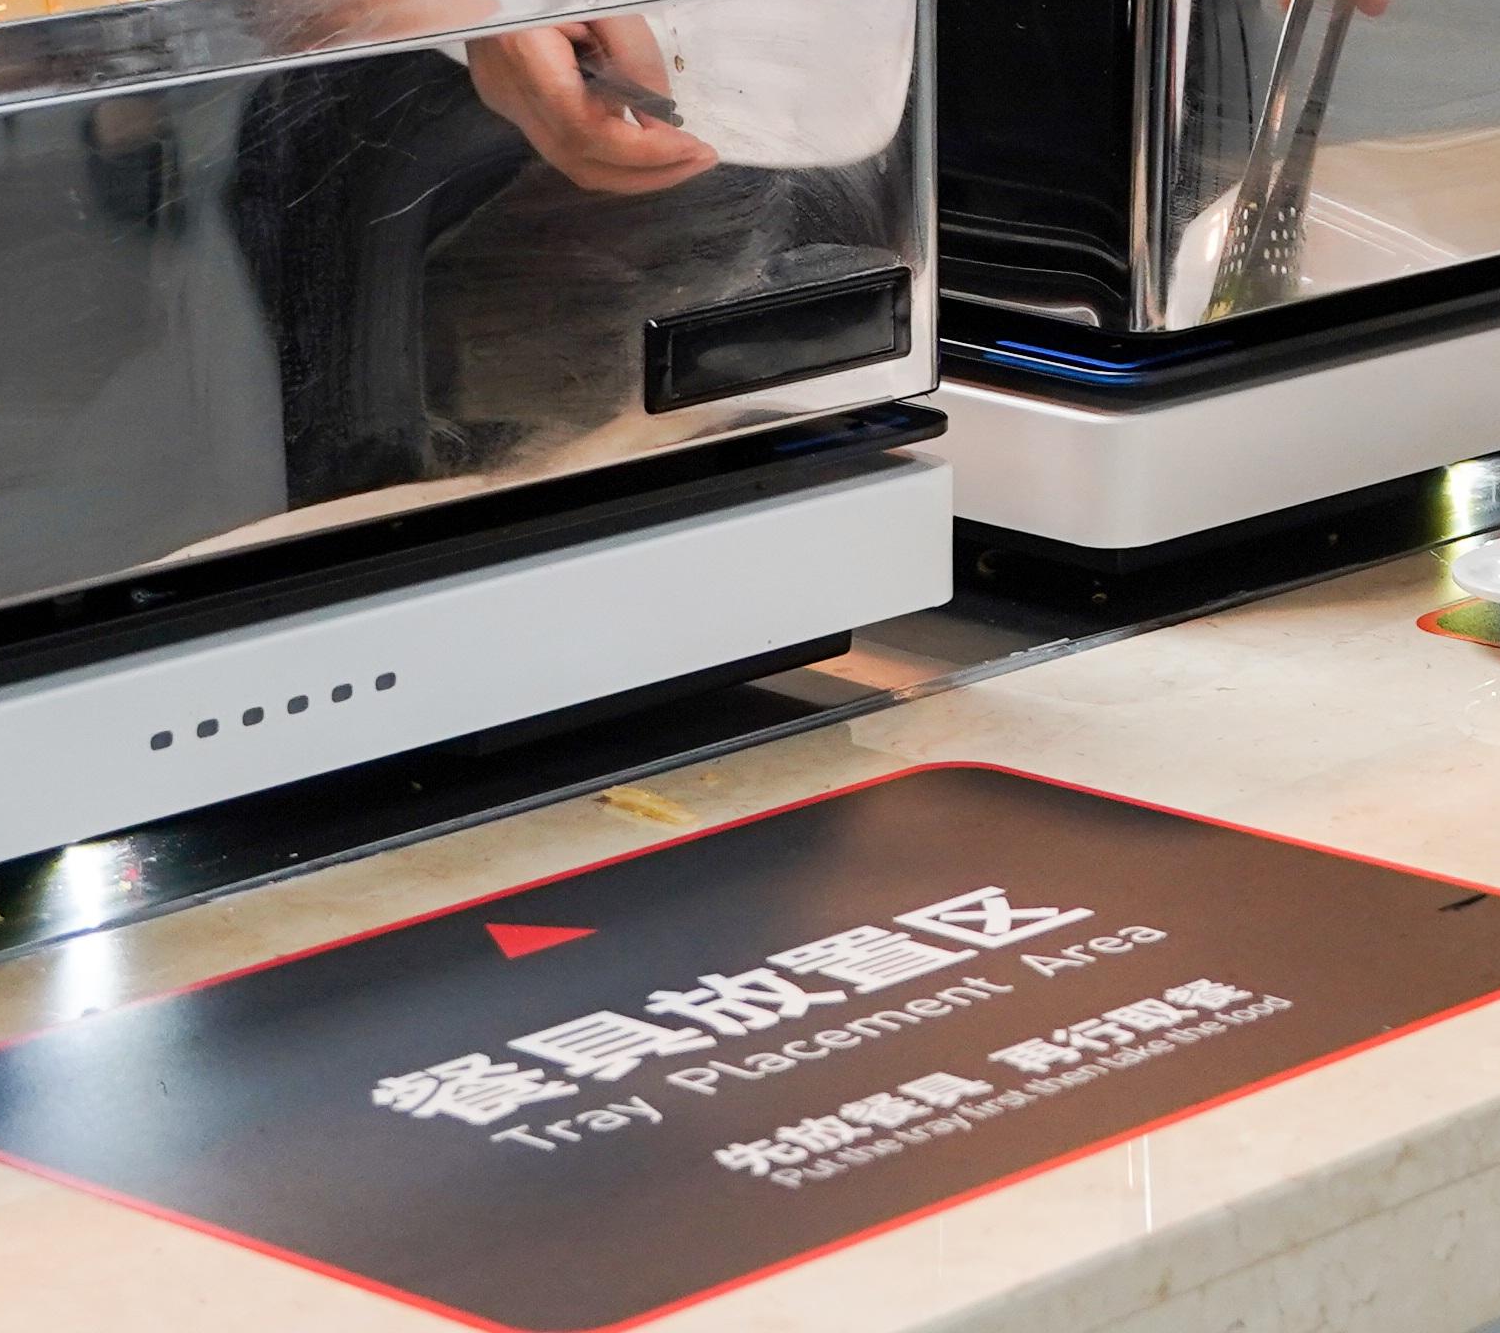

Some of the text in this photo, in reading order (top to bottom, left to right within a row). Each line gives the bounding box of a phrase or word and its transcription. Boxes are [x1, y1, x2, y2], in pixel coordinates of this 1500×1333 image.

[370, 885, 1096, 1126] 餐具放置区
[491, 921, 1168, 1153] Tray Placement Area
[713, 977, 1254, 1179] 先放餐具 再行取餐
[770, 1157, 849, 1190] Put
[835, 1136, 905, 1165] the
[895, 1110, 973, 1147] tray
[1160, 1017, 1229, 1045] the
[1210, 993, 1294, 1025] food
